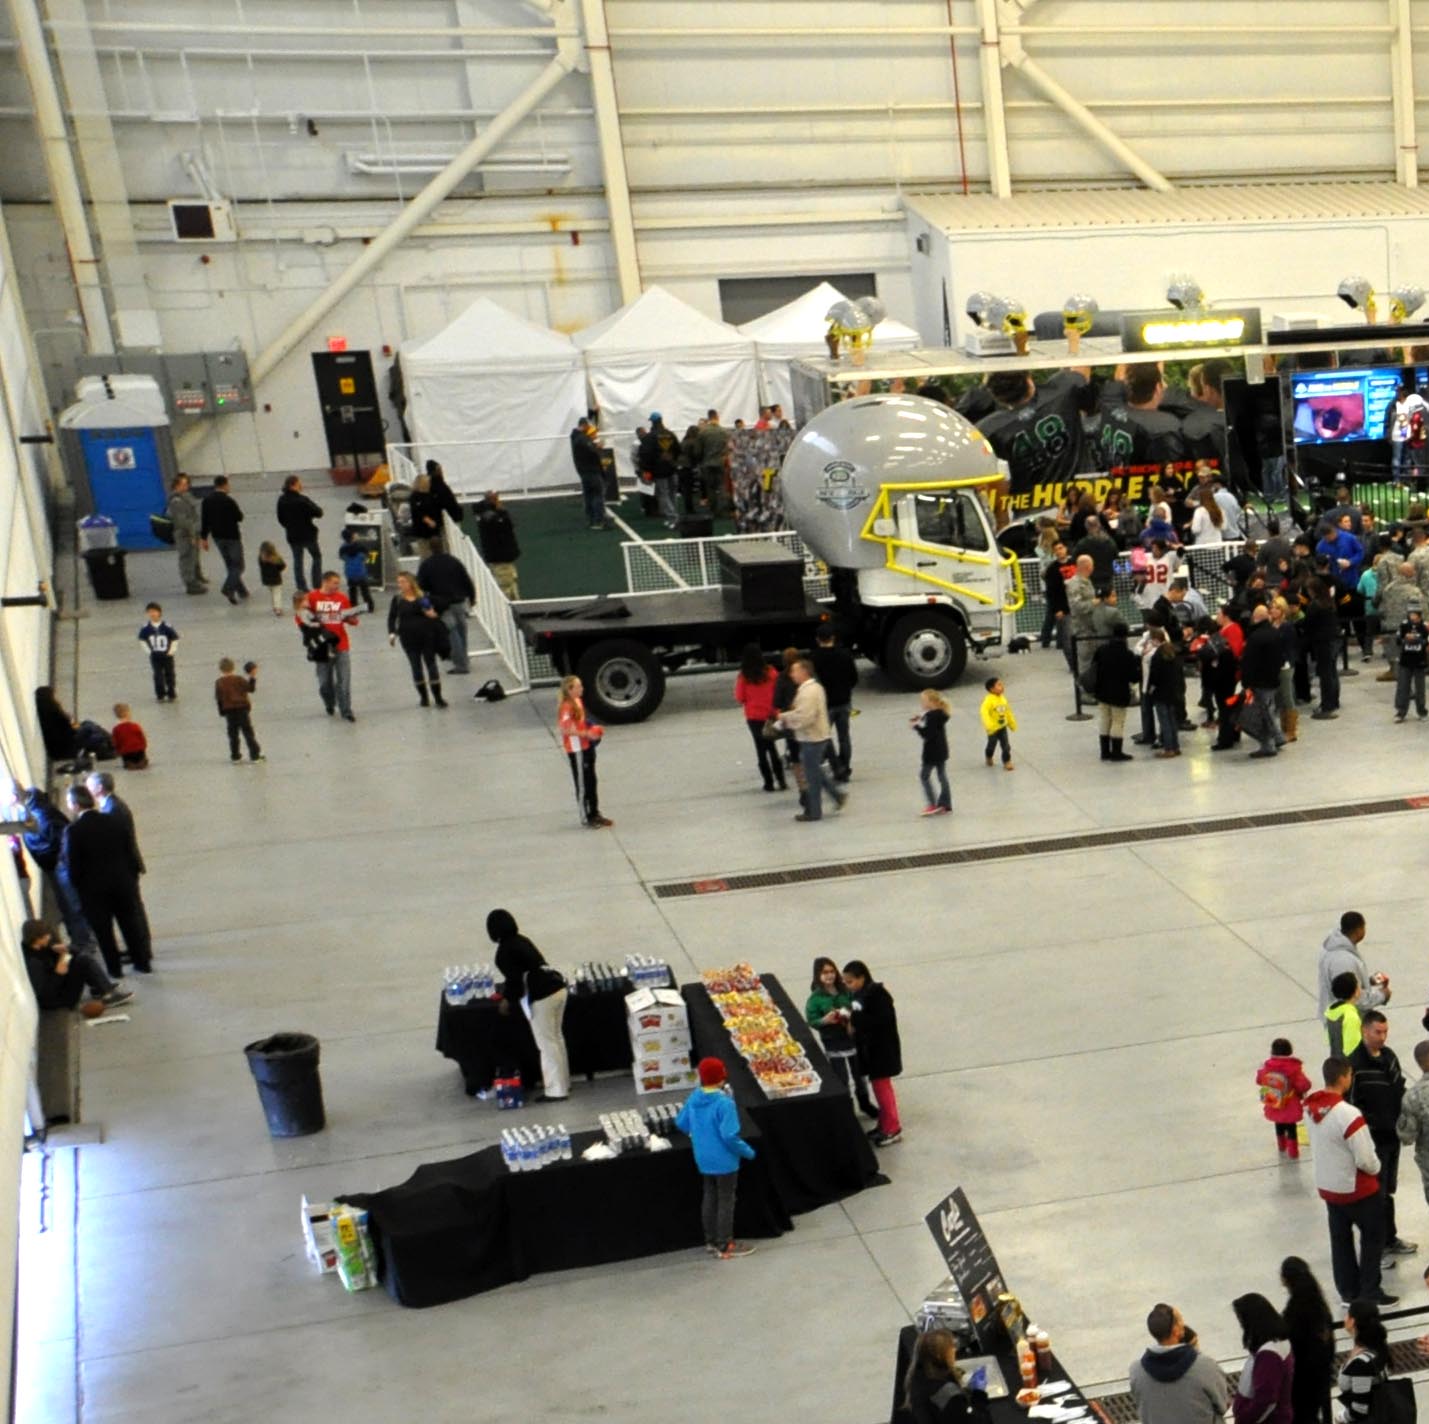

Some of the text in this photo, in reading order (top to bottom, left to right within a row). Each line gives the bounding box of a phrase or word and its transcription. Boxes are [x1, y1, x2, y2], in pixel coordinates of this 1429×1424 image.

[1001, 493, 1037, 511] THE
[1033, 474, 1143, 508] HUDDLE
[316, 600, 342, 613] NEW
[148, 635, 168, 652] 10
